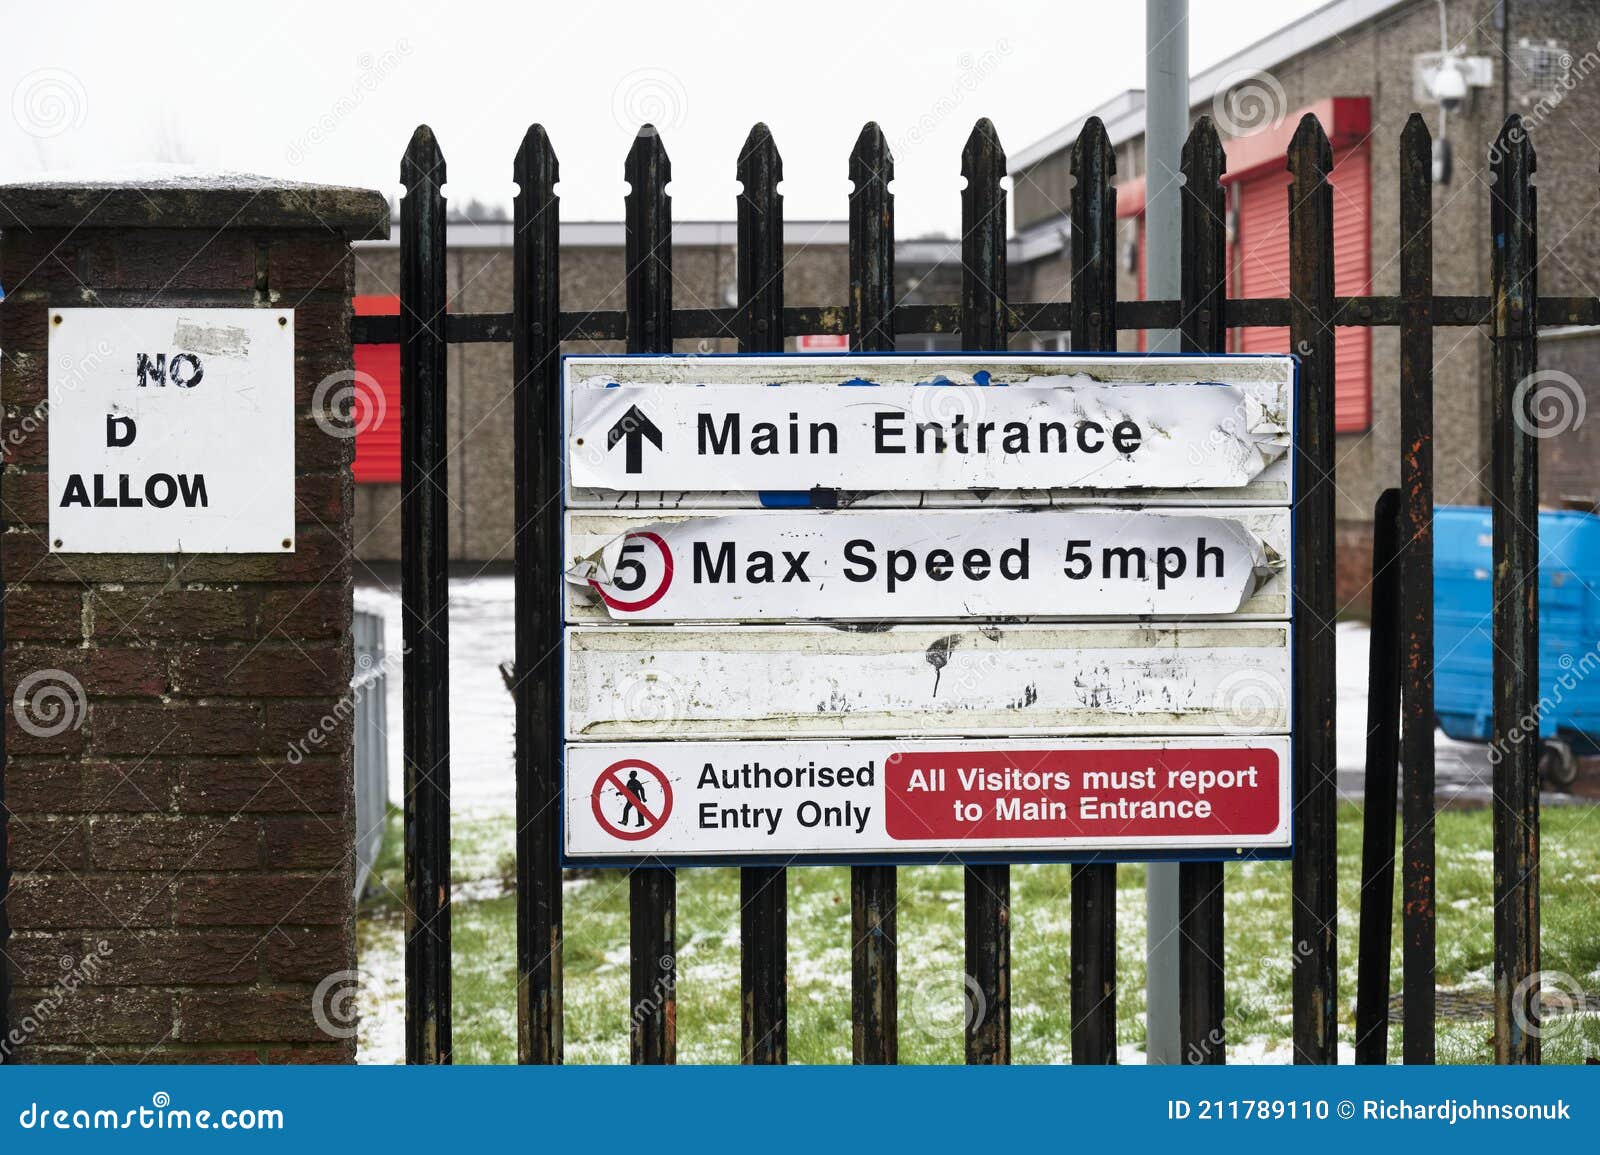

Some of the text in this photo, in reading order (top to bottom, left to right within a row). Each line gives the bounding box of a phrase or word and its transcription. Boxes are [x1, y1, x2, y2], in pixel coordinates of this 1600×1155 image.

[136, 353, 204, 388] NO
[106, 414, 137, 448] D
[697, 411, 1142, 456] Main Entrance
[612, 544, 647, 592] 5
[693, 537, 1225, 593] Max Speed 5mph
[697, 760, 875, 789] Authorised
[906, 766, 1258, 796] All Visitors must report
[698, 800, 871, 836] Entry Only
[953, 796, 1212, 822] to Main Entrance
